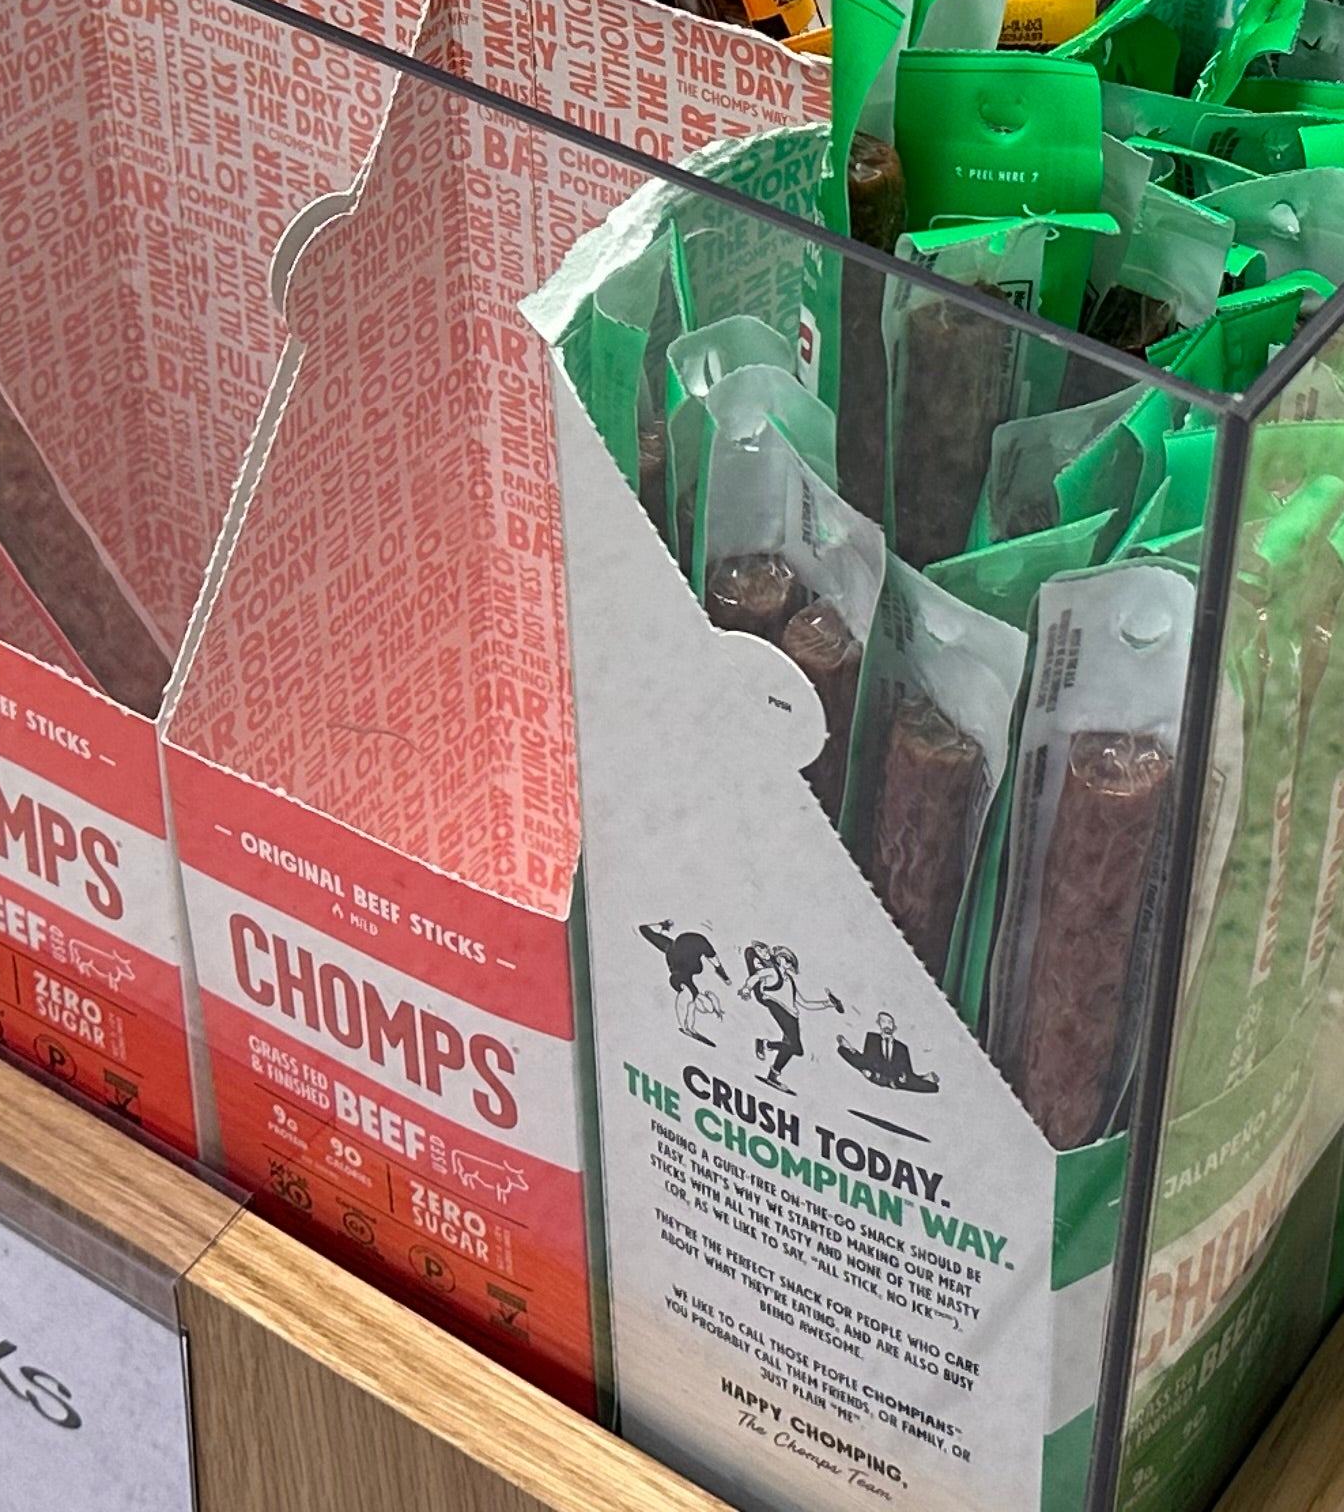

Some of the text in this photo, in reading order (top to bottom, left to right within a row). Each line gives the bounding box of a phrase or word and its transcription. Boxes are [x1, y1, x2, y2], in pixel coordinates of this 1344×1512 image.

[243, 61, 342, 121] SAVORY
[671, 20, 793, 78] SAVORY
[673, 47, 793, 110] THE DAY
[969, 168, 1025, 183] PEEL HERE
[450, 315, 528, 373] BAR
[230, 507, 317, 602] CRUSH
[232, 542, 318, 636] TODAY
[25, 708, 92, 761] STICKS
[474, 679, 549, 730] BAR
[239, 829, 487, 967] ORIGINAL BEEF STICKS
[31, 969, 103, 1028] ZERO
[34, 993, 106, 1051] SUGAR
[230, 912, 518, 1130] CHOMPS
[248, 1033, 328, 1091] GRASS FED
[266, 1061, 330, 1111] FINISHED
[333, 1079, 428, 1166] BEEF
[624, 1062, 680, 1121] THE
[921, 1206, 1014, 1272] WAY.
[683, 1065, 949, 1208] CRUSH TODAY.
[409, 1180, 487, 1240] ZERO
[411, 1203, 489, 1263] SUGAR
[649, 1152, 978, 1323] STICKS WITH ALL THE TASTY AND NONE OF THE NASTY
[651, 1119, 981, 1284] FINDING GUILT-FREE ON-THE-GO SNACK SHOULD BE
[690, 1159, 729, 1189] THAT'S
[733, 1181, 761, 1206] WHY
[765, 1197, 783, 1217] WE
[787, 1207, 842, 1245] STARTED
[847, 1234, 899, 1271] MAKING
[904, 1259, 933, 1284] OUR
[938, 1272, 970, 1301] MEAT
[655, 1207, 979, 1378] THEY'RE THE PERFECT SNACK FOR PEOPLE WHO CARE
[693, 1195, 708, 1213] AS
[712, 1206, 729, 1225] WE
[733, 1217, 756, 1239] LIKE
[761, 1230, 778, 1250] TO
[887, 1288, 906, 1308] NO
[660, 1227, 699, 1260] ABOUT
[704, 1252, 736, 1280] WHAT
[740, 1271, 787, 1306] THEY'RE
[843, 1321, 871, 1346] AND
[876, 1337, 899, 1360] ARE
[905, 1350, 938, 1377] ALSO
[943, 1366, 973, 1393] BUSY
[672, 1284, 858, 1393] WE LIKE TO CALL THOSE PEOPLE
[759, 1299, 795, 1327] BEING
[664, 1295, 688, 1318] YOU
[691, 1311, 750, 1353] PROBABLY
[754, 1346, 781, 1370] CALL
[785, 1362, 818, 1389] THEM
[878, 1407, 898, 1428] OR
[951, 1441, 971, 1464] OR
[759, 1365, 825, 1409] JUST PLAIN
[721, 1376, 907, 1489] HAPPY CHOMPING,
[737, 1409, 892, 1501] The Chomps Team
